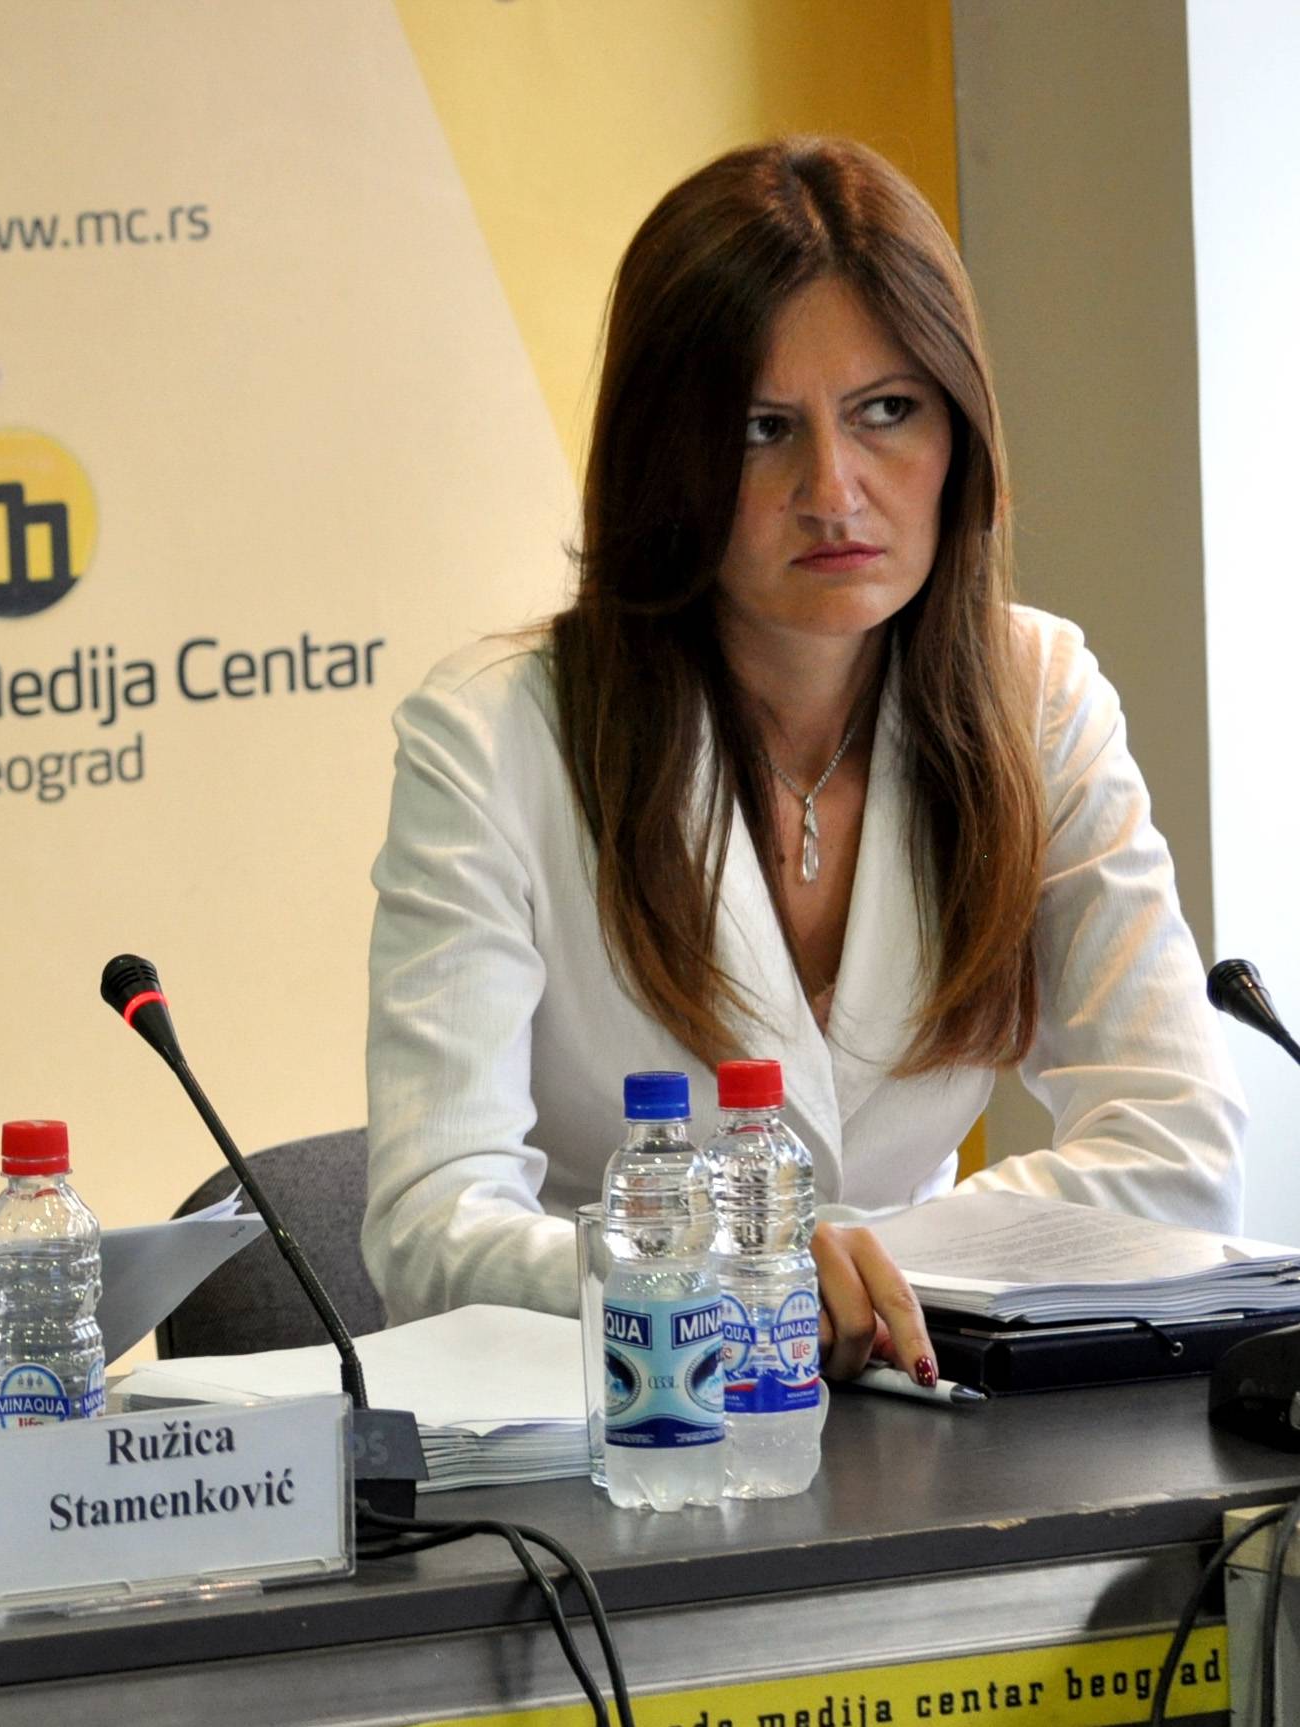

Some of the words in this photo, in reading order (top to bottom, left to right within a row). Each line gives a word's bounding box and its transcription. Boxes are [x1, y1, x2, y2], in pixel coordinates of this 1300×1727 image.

[176, 632, 386, 704] Centar
[106, 1419, 236, 1466] Ružica
[48, 1467, 296, 1533] Stamenković
[757, 1694, 893, 1727] medija
[915, 1680, 1045, 1719] centar
[1065, 1647, 1223, 1701] beogad
